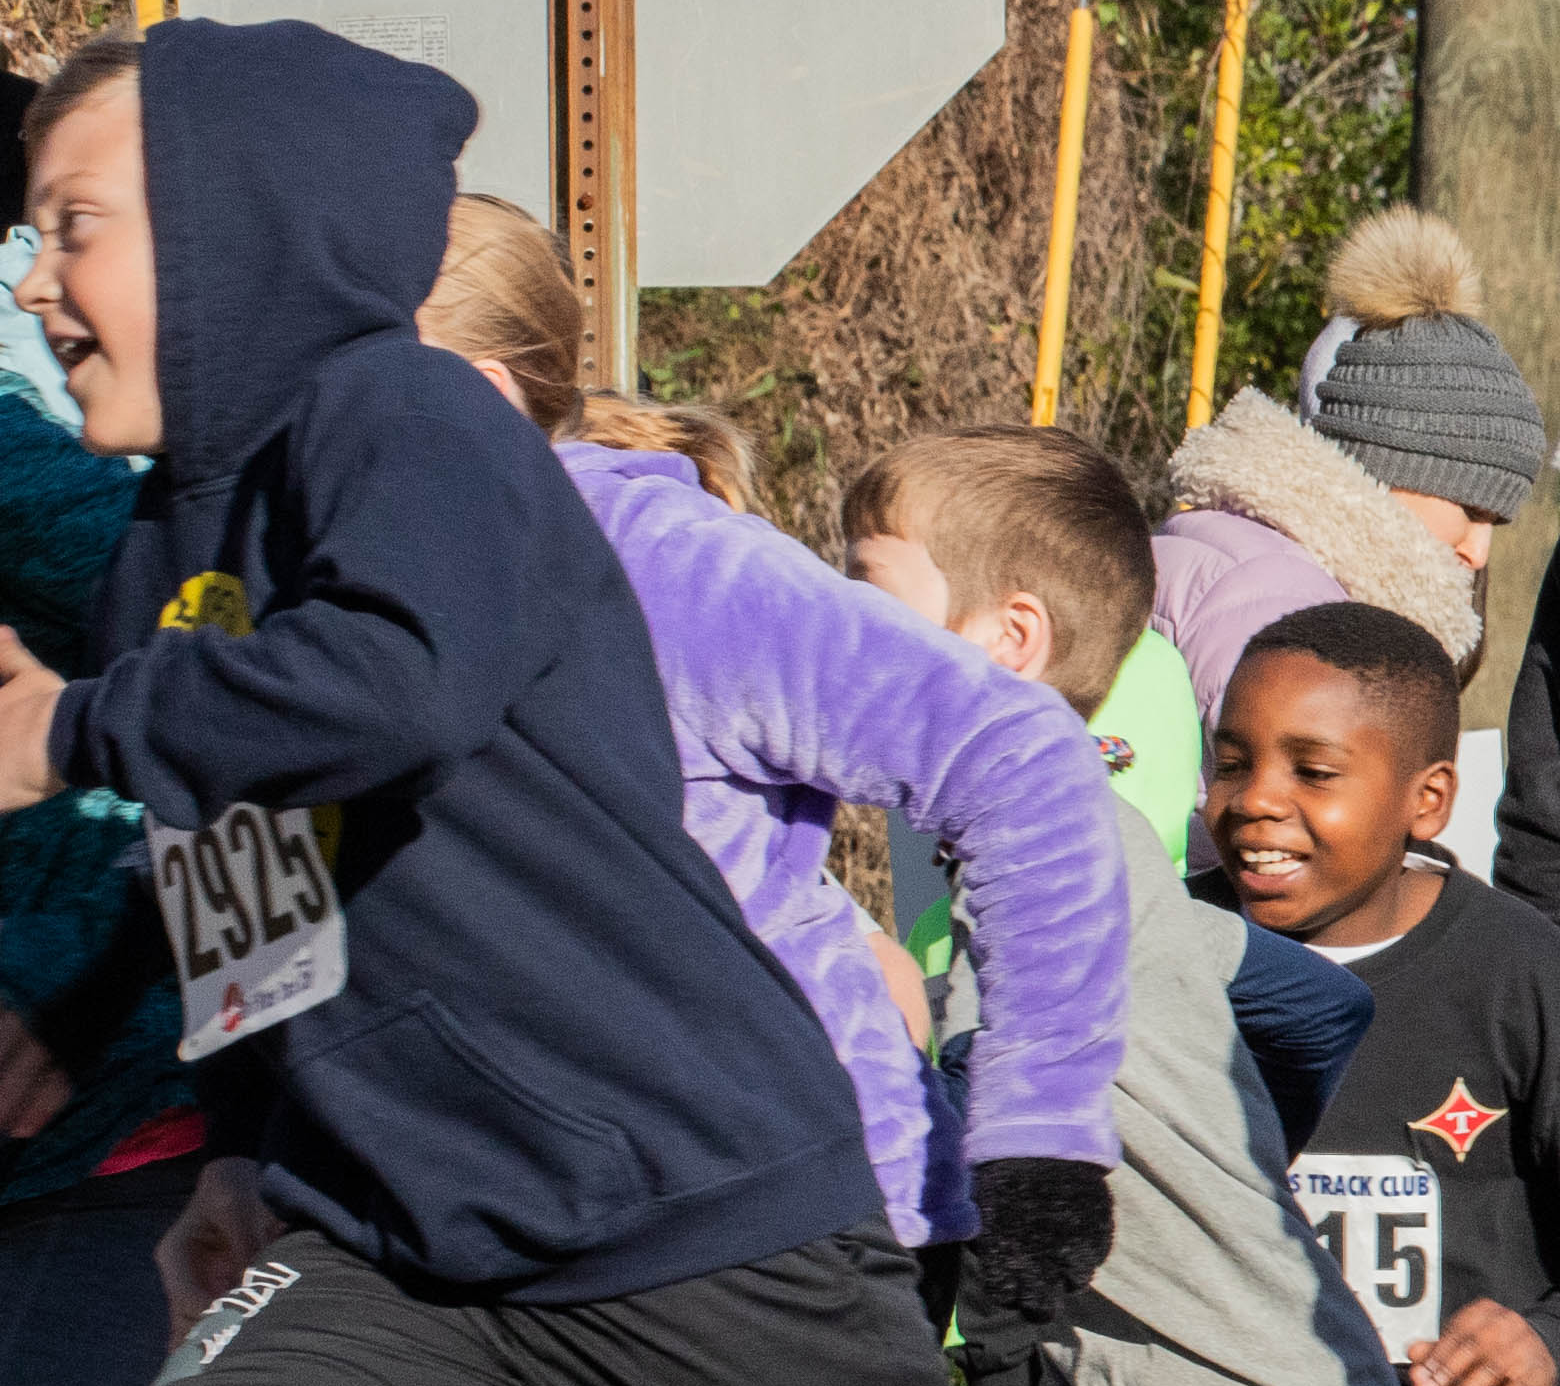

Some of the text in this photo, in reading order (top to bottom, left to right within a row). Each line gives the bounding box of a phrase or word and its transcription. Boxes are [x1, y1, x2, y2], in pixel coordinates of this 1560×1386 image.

[162, 809, 329, 980] 2925
[1445, 1111, 1477, 1134] T
[1308, 1174, 1371, 1196] TRACK
[1381, 1174, 1430, 1197] CLUB
[1316, 1211, 1428, 1307] 15
